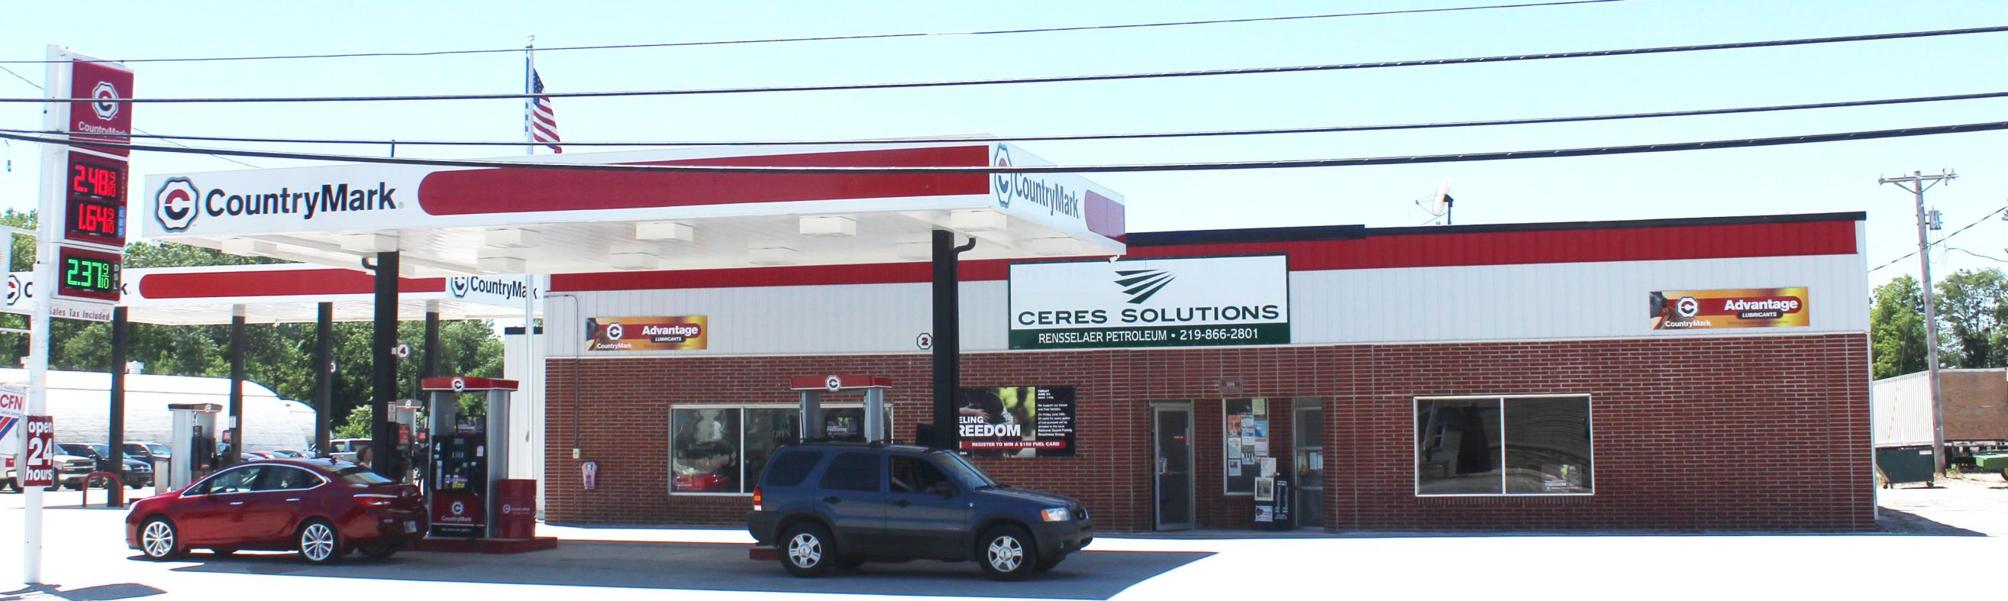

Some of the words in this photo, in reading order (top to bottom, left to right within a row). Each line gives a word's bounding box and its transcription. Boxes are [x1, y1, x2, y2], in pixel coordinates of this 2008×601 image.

[205, 181, 397, 219] CountryMark
[1014, 172, 1079, 218] CountryMark
[470, 276, 538, 299] CountryMak
[1724, 299, 1798, 312] Advantage
[69, 308, 80, 318] Tax
[1018, 309, 1108, 326] CERES
[1121, 304, 1279, 323] SOLUTIONS
[641, 325, 699, 337] Advantage
[1664, 320, 1711, 328] CountryMark
[921, 337, 929, 346] 2
[1038, 331, 1103, 344] RENSSELAER
[1106, 329, 1167, 342] PETROLEUM
[1179, 327, 1259, 341] 219-866-2801
[0, 394, 23, 411] CFN
[959, 416, 984, 424] ELING
[28, 421, 53, 436] open
[959, 424, 1021, 437] REEDOM
[27, 437, 53, 466] 24
[26, 466, 53, 480] hours
